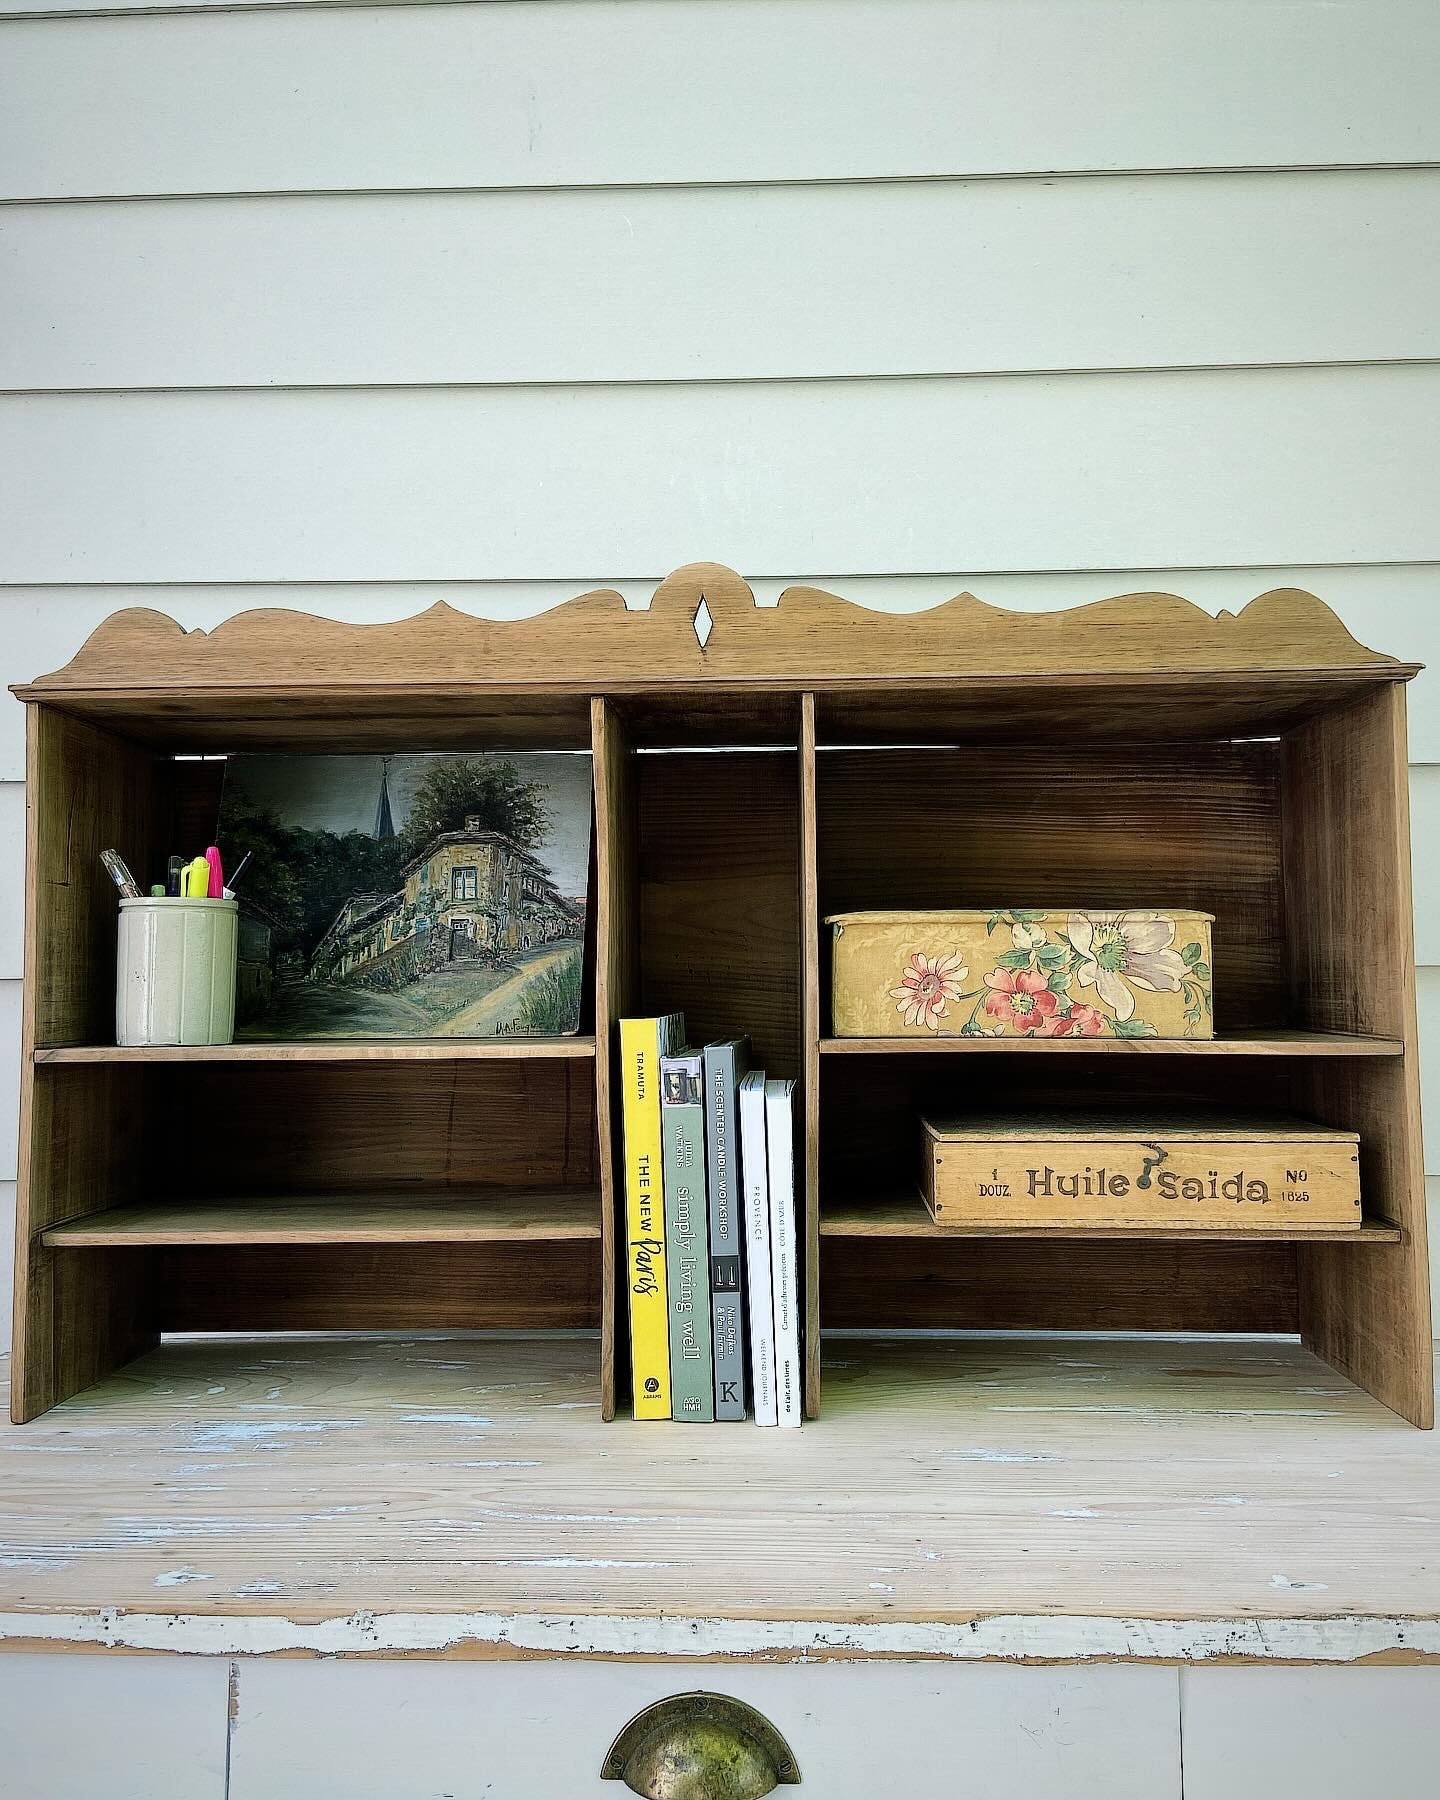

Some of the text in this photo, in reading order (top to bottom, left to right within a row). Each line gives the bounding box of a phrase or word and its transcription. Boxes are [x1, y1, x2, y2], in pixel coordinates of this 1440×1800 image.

[636, 1051, 645, 1100] TRAMUTA
[675, 1125, 684, 1168] WATKINS
[684, 1140, 693, 1167] JULIA
[714, 1068, 728, 1240] THE SCENTED CANDLE WORKSHOP
[638, 1154, 652, 1232] THE NEW
[978, 1183, 1012, 1197] DOUZ.
[1025, 1165, 1272, 1205] Huile Saïda
[753, 1186, 762, 1241] PROVENCE
[630, 1237, 664, 1298] Paris
[672, 1186, 701, 1361] simply living well
[717, 1315, 725, 1333] Paul
[726, 1306, 737, 1355] Niko Dafkos
[718, 1334, 726, 1360] Firmin
[683, 1403, 702, 1412] HMH
[719, 1381, 739, 1403] K
[761, 1373, 769, 1406] JOURNALS
